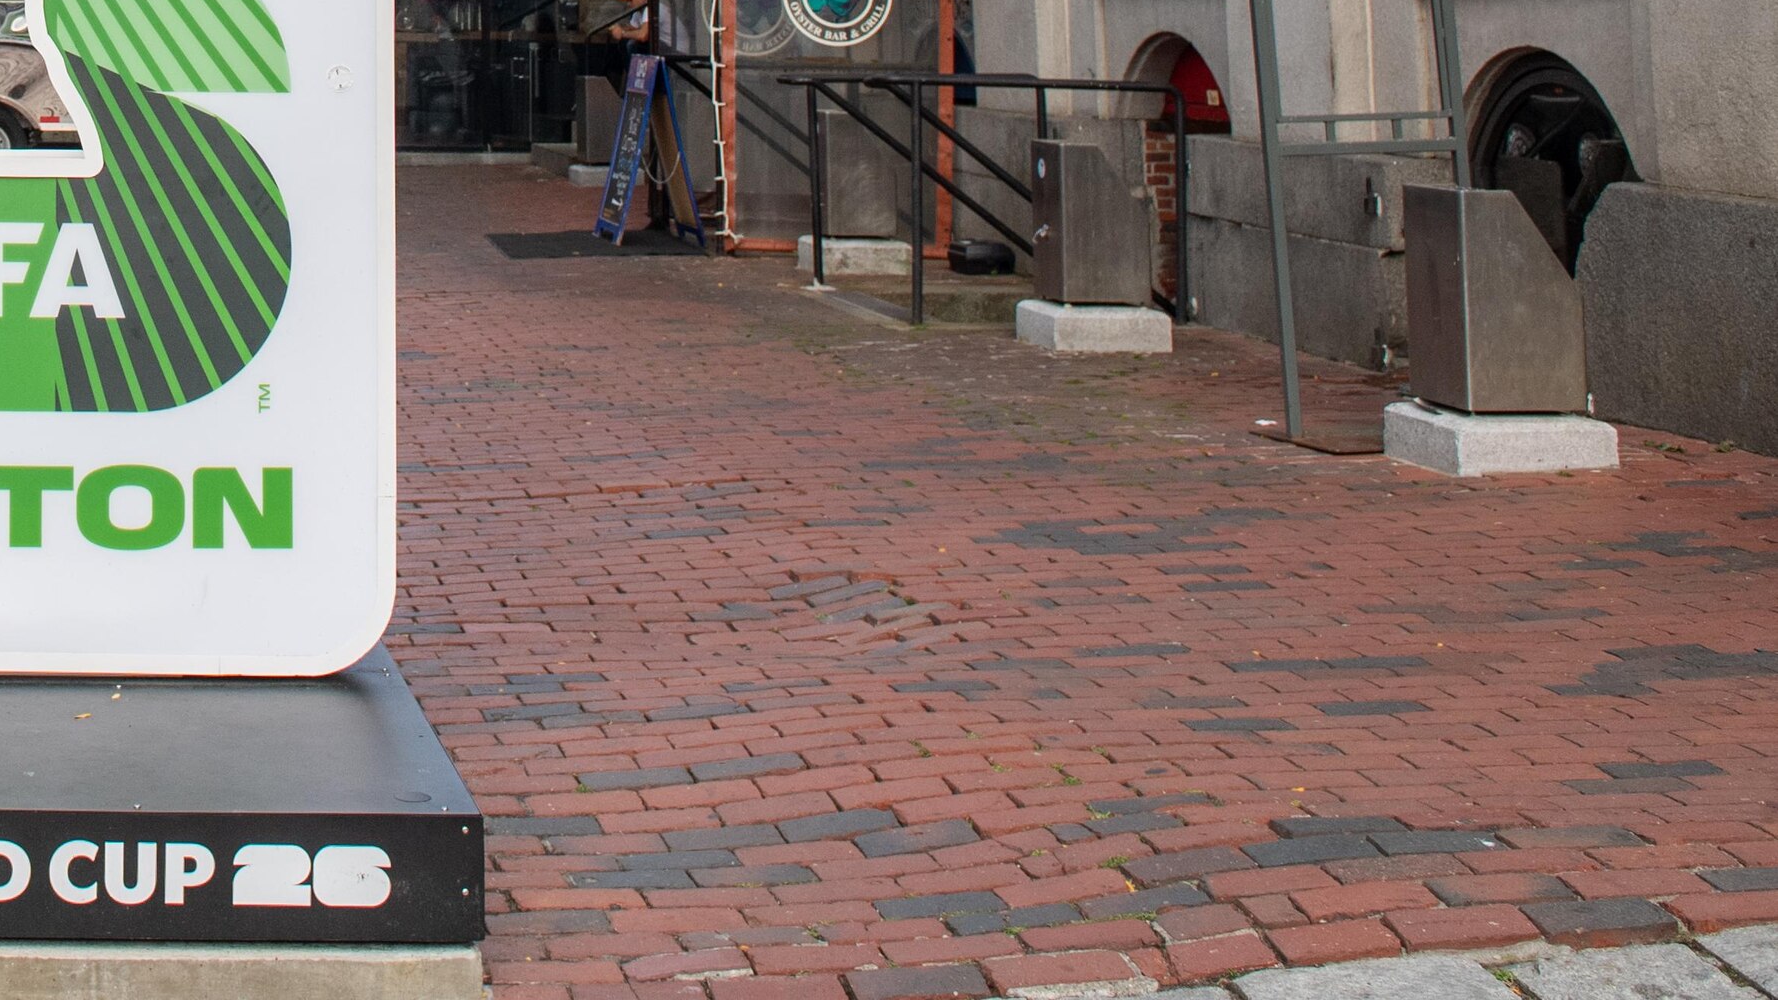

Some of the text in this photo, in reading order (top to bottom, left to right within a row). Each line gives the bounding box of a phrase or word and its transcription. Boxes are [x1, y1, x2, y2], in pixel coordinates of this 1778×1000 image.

[790, 1, 885, 41] OYSTER BAR & GRILL
[48, 840, 215, 906] CUP
[232, 843, 392, 907] 26
